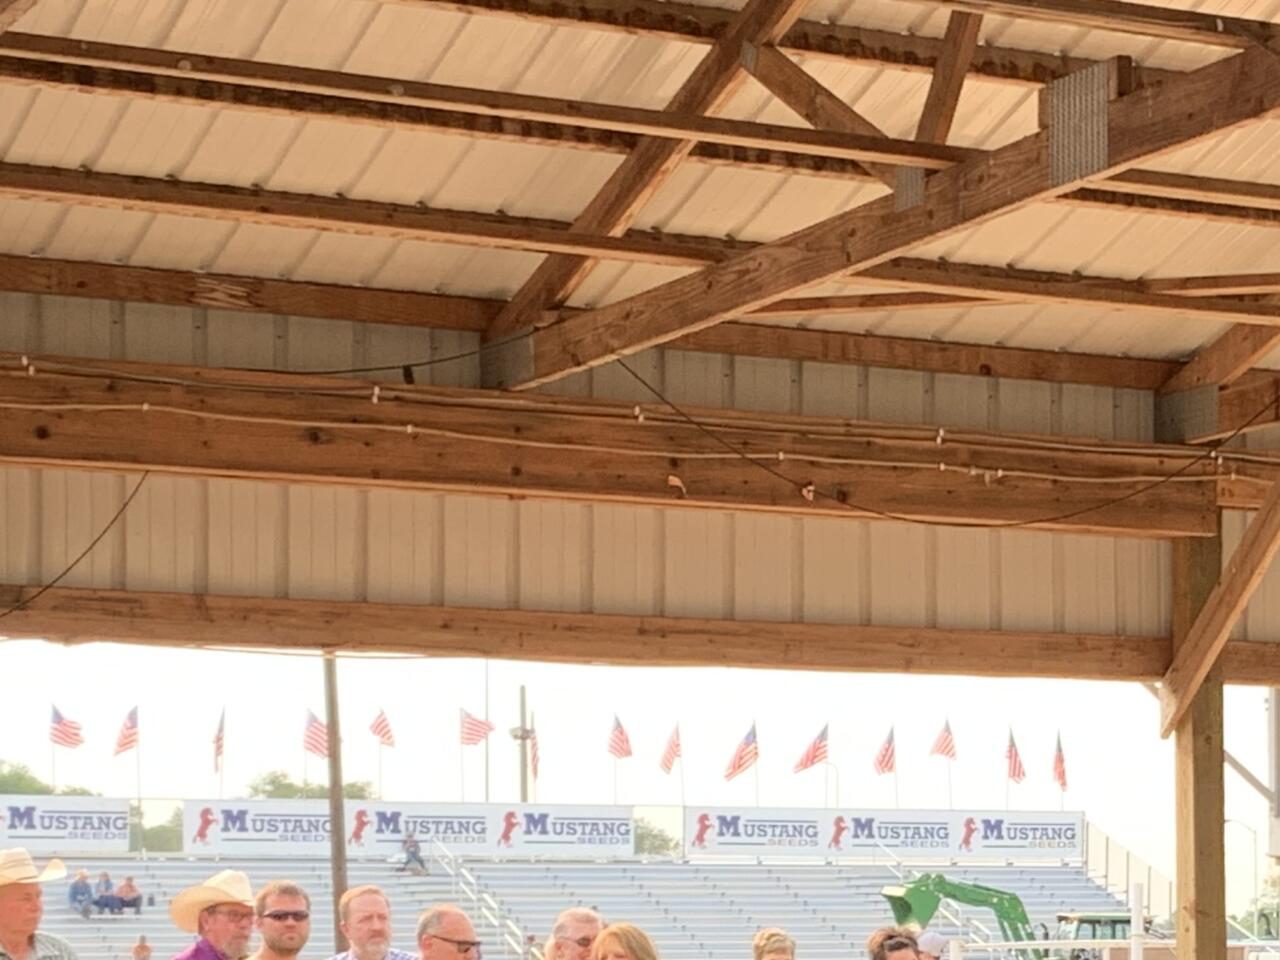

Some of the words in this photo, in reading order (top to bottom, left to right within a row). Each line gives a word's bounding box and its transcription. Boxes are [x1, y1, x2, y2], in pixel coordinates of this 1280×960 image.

[8, 806, 128, 830] MUSTANG
[375, 811, 487, 835] MUSTANG
[523, 813, 630, 836] MUSTANG
[717, 815, 819, 838] MUSTANG
[851, 817, 949, 840] MUSTANG
[68, 832, 128, 840] SEEDS
[577, 837, 630, 845] SEEDS
[981, 819, 1076, 841] MUSTANG
